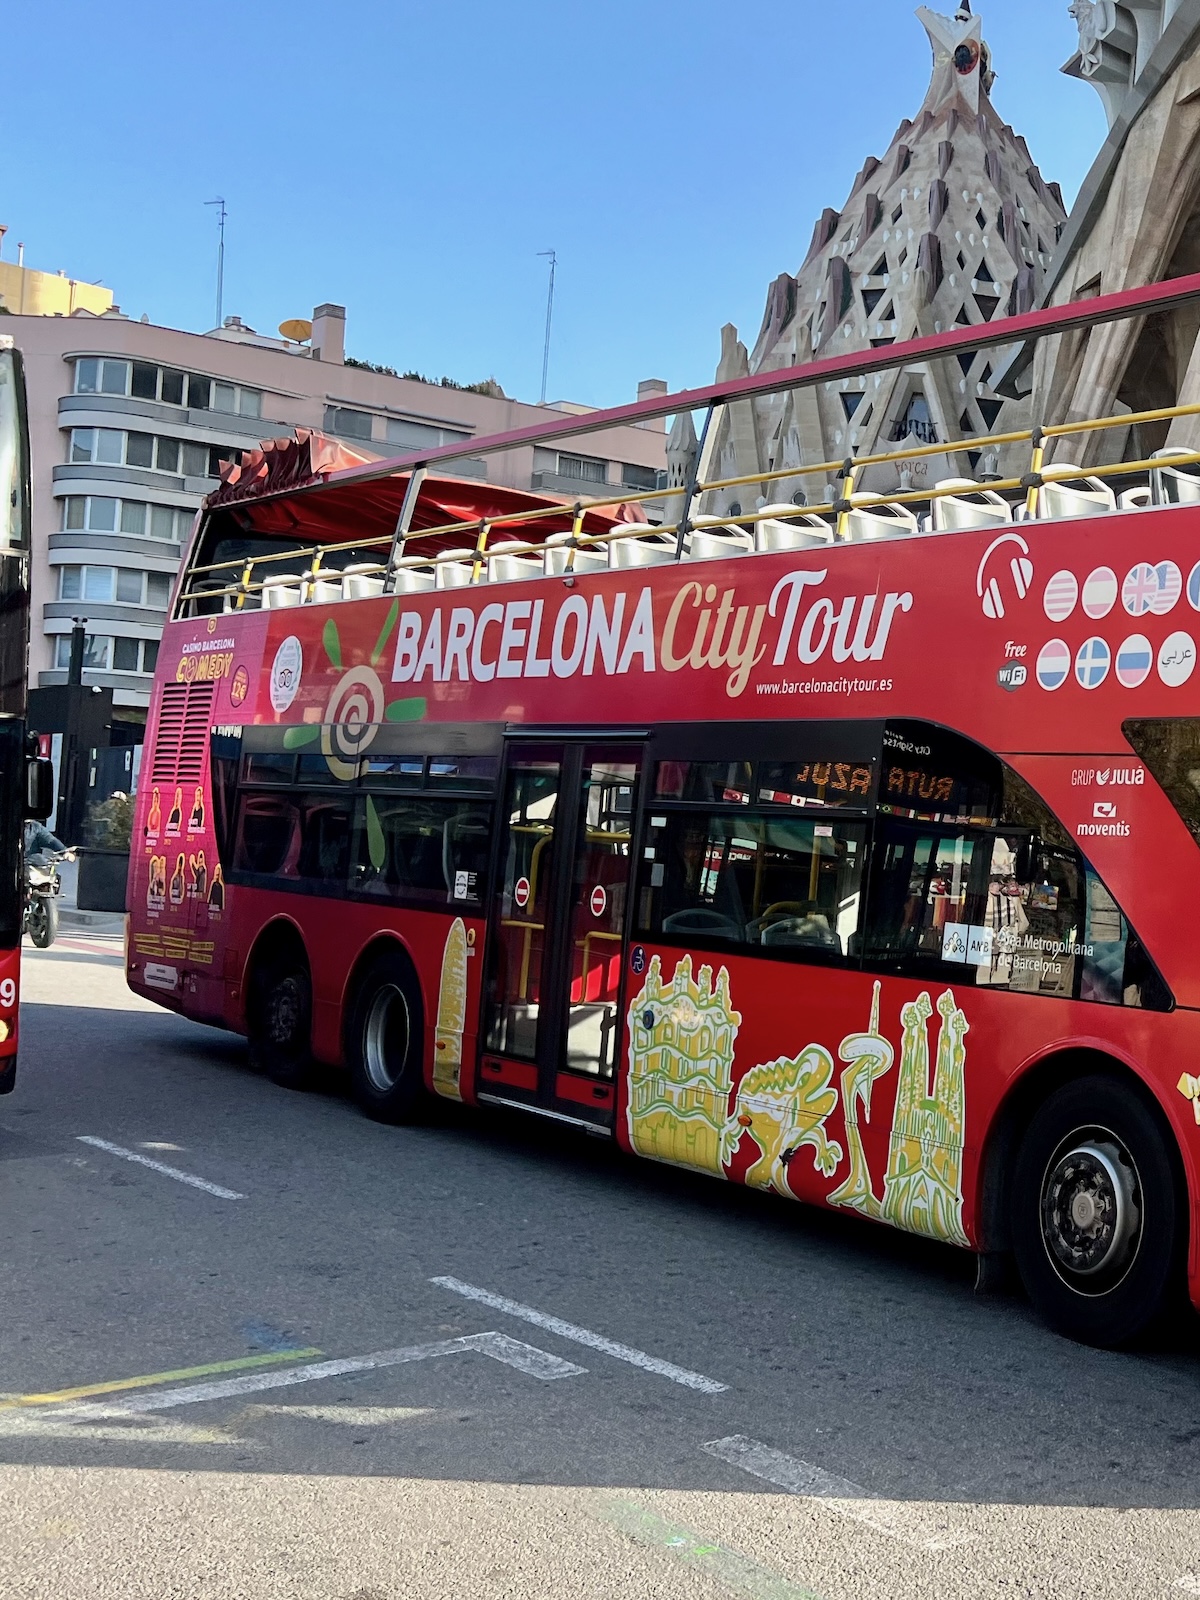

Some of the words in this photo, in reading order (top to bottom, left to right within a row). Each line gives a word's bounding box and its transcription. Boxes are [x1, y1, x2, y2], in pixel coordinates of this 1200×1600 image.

[201, 638, 235, 651] BARCELONA
[391, 587, 656, 682] BARCELONA
[1004, 640, 1027, 658] Free
[999, 665, 1027, 686] WiFi
[756, 677, 893, 696] www.barcelonacitytour.es
[1071, 769, 1095, 786] GRUP
[1077, 820, 1130, 836] moventis
[1024, 935, 1094, 957] Metropolitana
[998, 953, 1011, 967] de
[1013, 954, 1062, 974] Barcelona
[0, 978, 16, 1007] 9
